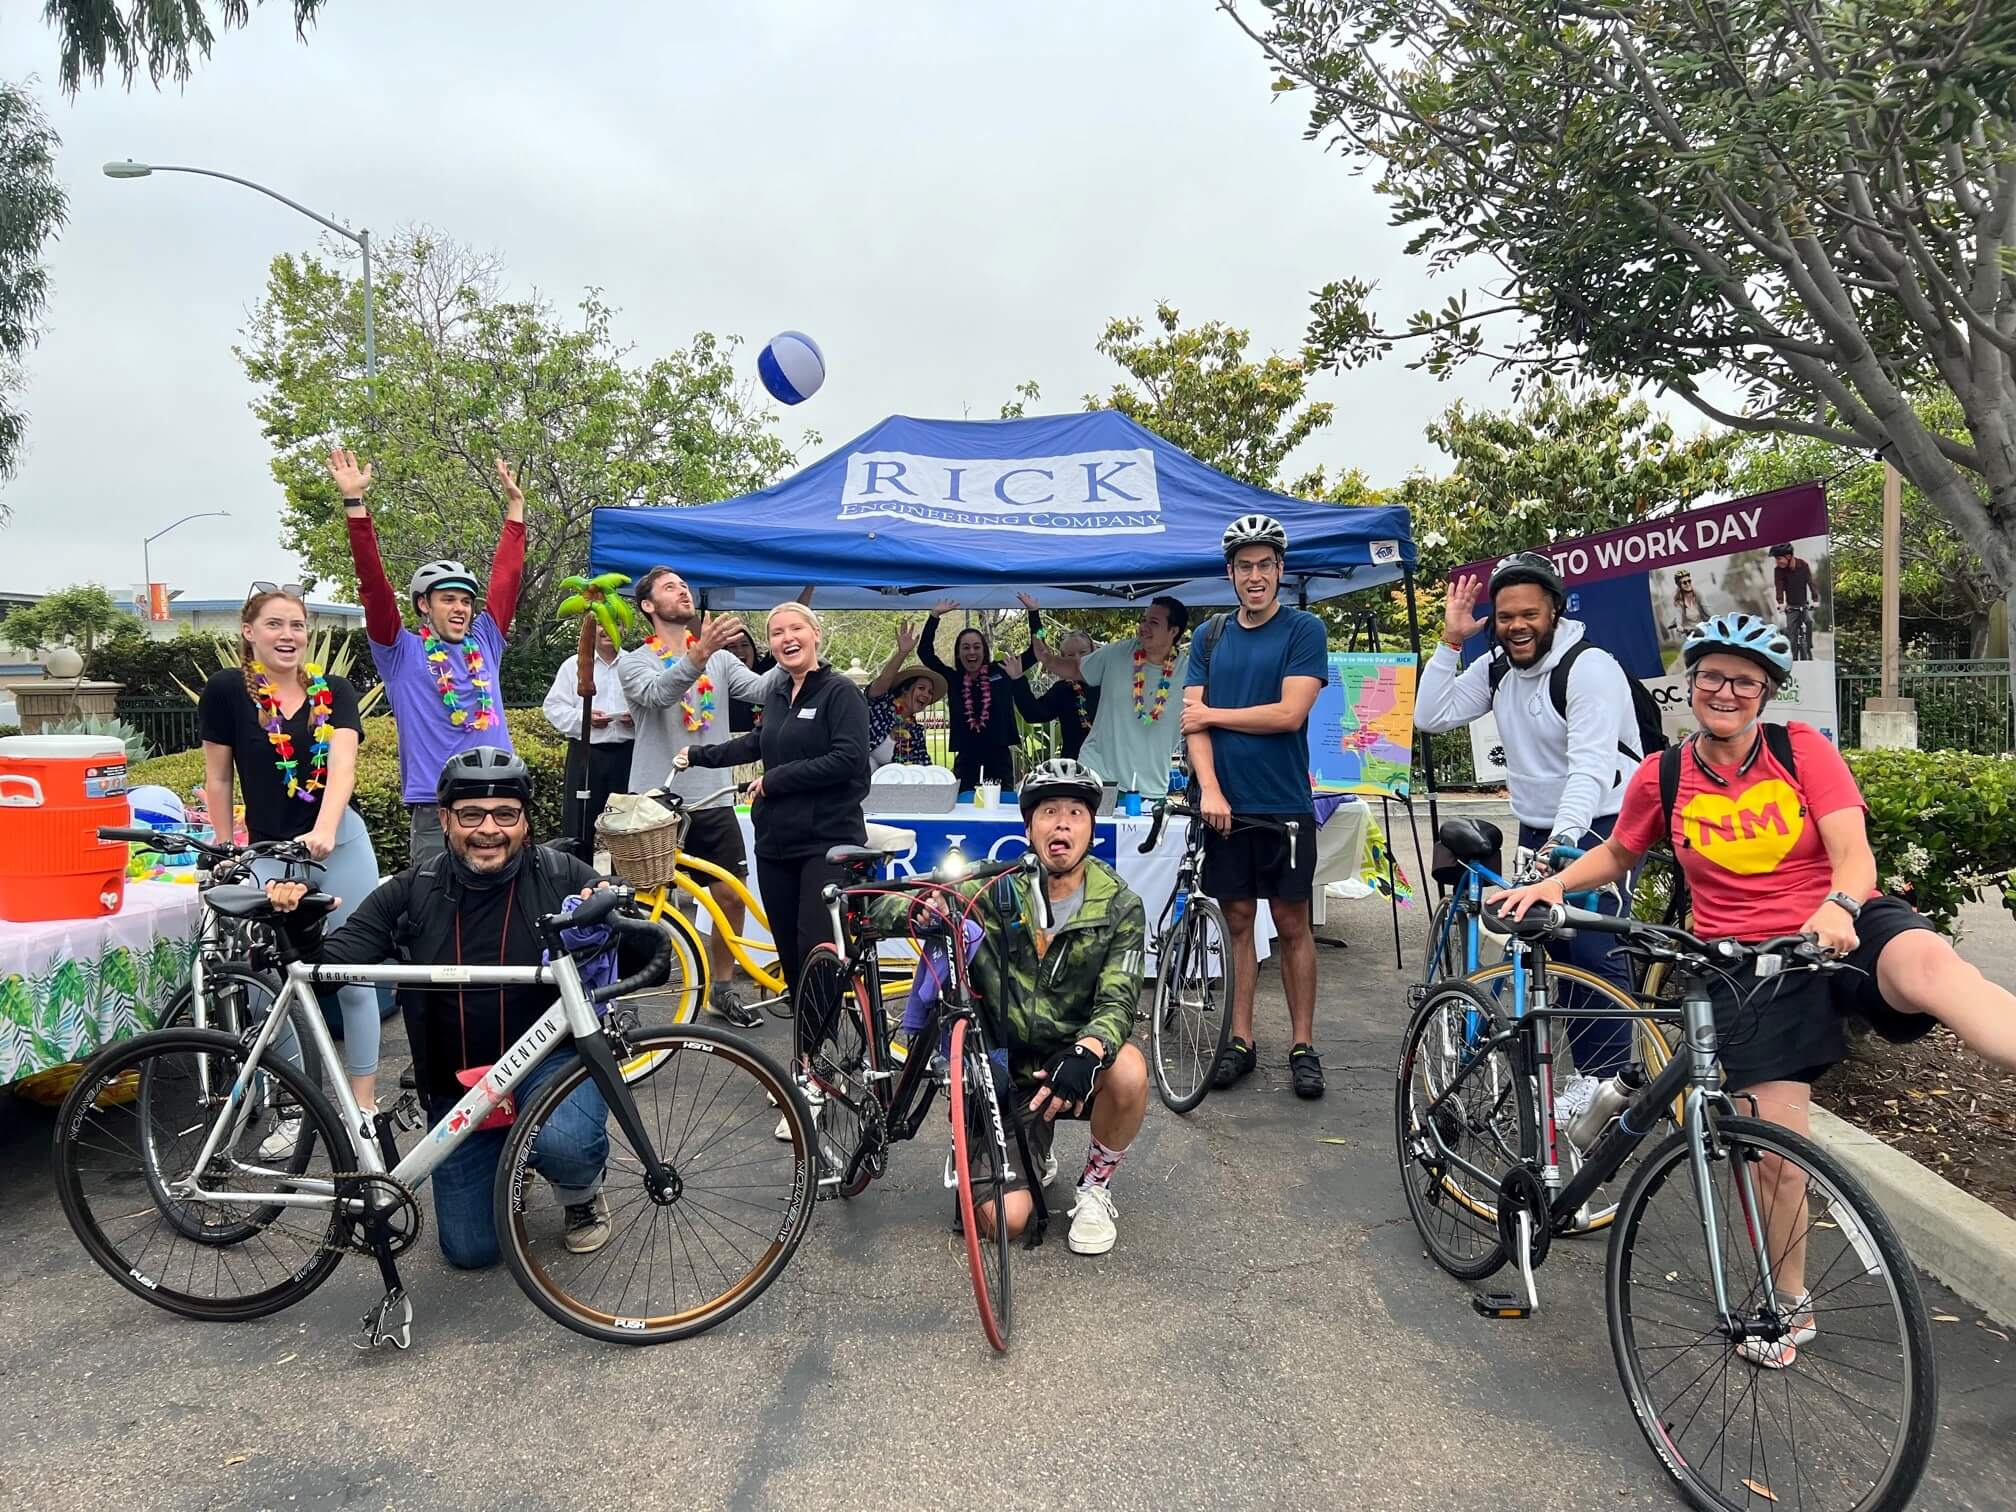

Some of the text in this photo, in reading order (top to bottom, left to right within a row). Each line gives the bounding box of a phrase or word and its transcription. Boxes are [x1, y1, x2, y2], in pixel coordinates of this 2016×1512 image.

[859, 460, 1143, 506] RICK
[841, 503, 1162, 529] ENGINEERING COMPANY
[1552, 507, 1762, 578] TO WORK DAY
[1121, 823, 1137, 833] TM
[1696, 801, 1789, 846] NM
[494, 1019, 557, 1087] AVENTON
[979, 1053, 1007, 1148] RALEIGH
